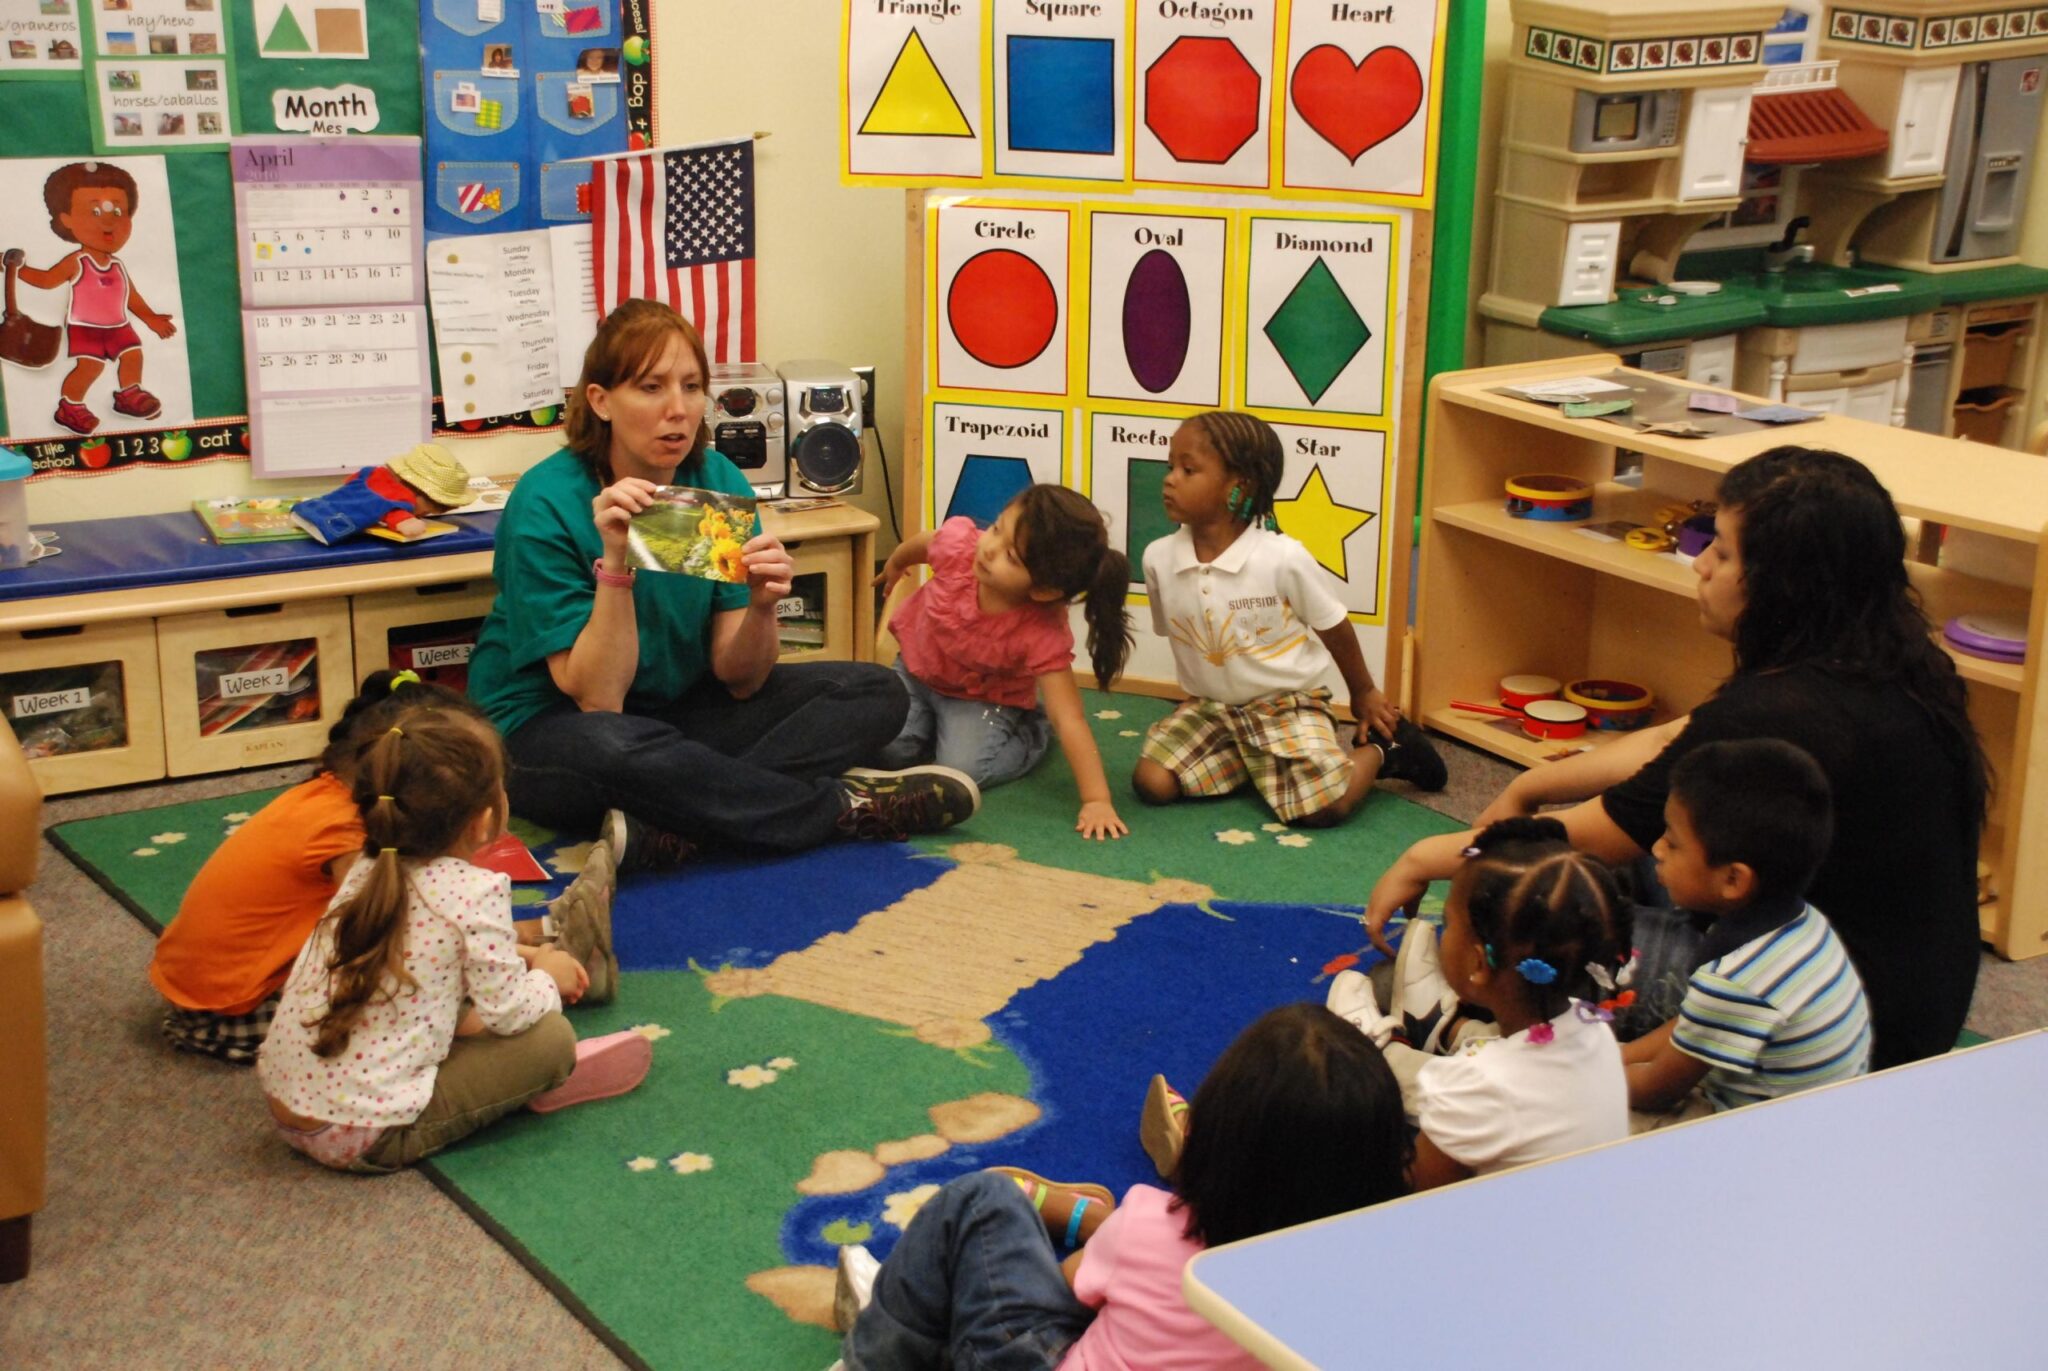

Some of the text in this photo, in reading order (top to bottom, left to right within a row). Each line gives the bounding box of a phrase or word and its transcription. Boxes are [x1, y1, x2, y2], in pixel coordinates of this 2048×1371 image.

[874, 0, 961, 24] Triangle
[1026, 0, 1101, 21] Square
[1158, 0, 1253, 28] Octagon
[1331, 4, 1395, 24] Heart
[127, 15, 195, 32] hay/heno
[628, 73, 647, 107] dog
[113, 94, 218, 107] horses/caballos
[285, 92, 368, 119] Month
[312, 120, 342, 134] Mes
[245, 148, 293, 172] April
[273, 231, 281, 242] 5
[296, 231, 304, 241] 6
[318, 230, 325, 240] 7
[342, 229, 350, 240] 8
[364, 228, 372, 239] 9
[387, 228, 401, 239] 10
[974, 220, 1036, 240] Circle
[1134, 227, 1184, 247] Oval
[502, 245, 531, 255] Sunday
[1275, 232, 1373, 253] Diamond
[253, 266, 401, 282] 11 12 13 14 15 16 17
[504, 268, 535, 278] Monday
[508, 288, 540, 298] Tuesday
[256, 313, 406, 328] 18 19 20 21 22 23 24
[506, 310, 550, 322] Wednesday
[521, 336, 554, 349] Thursday
[259, 352, 387, 367] 25 26 27 28 29 30
[527, 362, 549, 372] Friday
[522, 388, 554, 400] Saturday
[945, 416, 1050, 440] Trapezoid
[1110, 426, 1173, 446] Recta
[118, 437, 160, 457] 1 2 3
[200, 429, 233, 449] cat
[1296, 437, 1341, 457] Star
[44, 442, 66, 459] like
[32, 455, 76, 470] school
[777, 600, 802, 614] ek 5
[418, 647, 461, 665] Week
[225, 674, 285, 694] Week 2
[18, 692, 83, 714] Week 1
